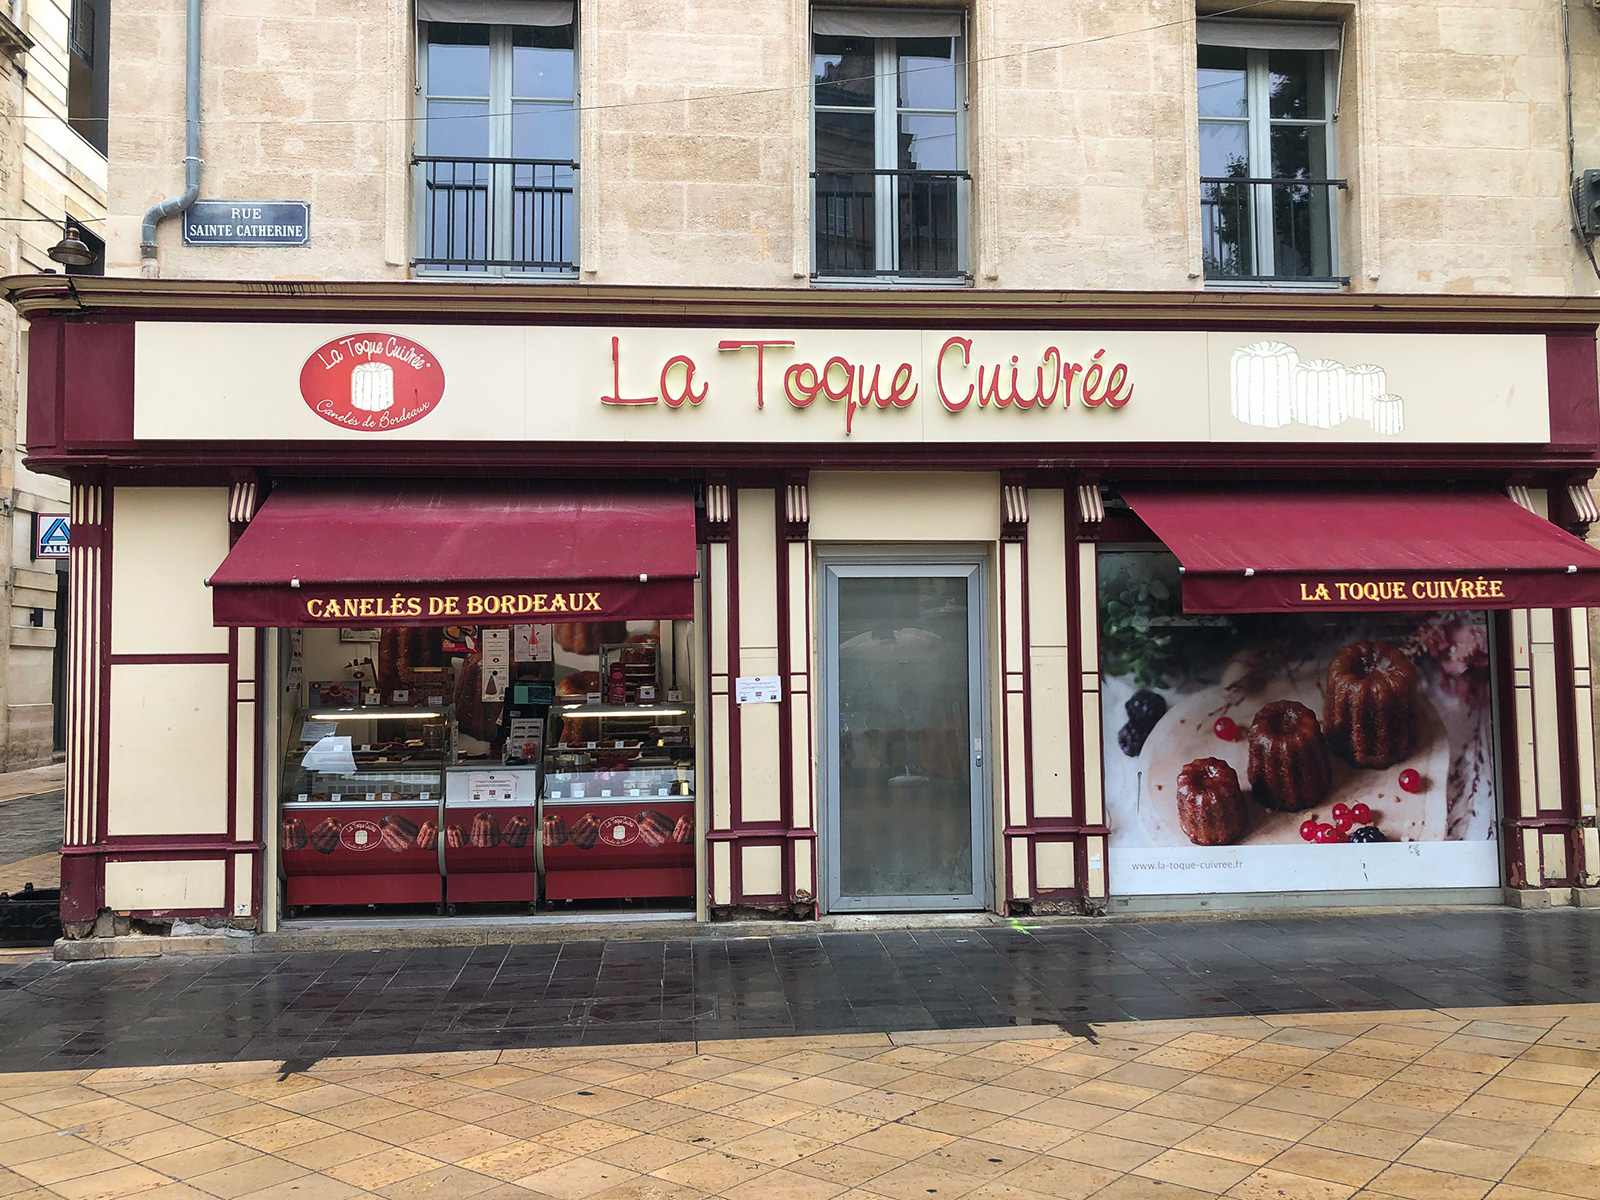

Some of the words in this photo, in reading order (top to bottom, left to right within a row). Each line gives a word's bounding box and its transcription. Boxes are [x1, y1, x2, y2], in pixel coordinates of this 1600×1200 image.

[231, 207, 262, 220] RUE
[189, 224, 233, 237] SAINTE
[236, 225, 303, 237] CATHERINE
[317, 349, 344, 370] La
[339, 337, 384, 361] Toque
[385, 336, 426, 370] Cuivrée
[600, 336, 709, 409] La
[717, 340, 919, 436] Toque
[936, 336, 1135, 413] Cuivrée
[316, 399, 361, 426] Canelés
[361, 414, 377, 428] de
[378, 401, 430, 428] Bordeaux
[1300, 583, 1331, 601] LA
[1335, 582, 1408, 601] TOQUE
[1411, 576, 1505, 599] CUIVRÉE
[307, 593, 421, 618] CANELÉS
[428, 596, 461, 616] DE
[467, 592, 602, 615] BORDEAUX
[1131, 860, 1244, 871] www.la-toque-cuivree.fr
